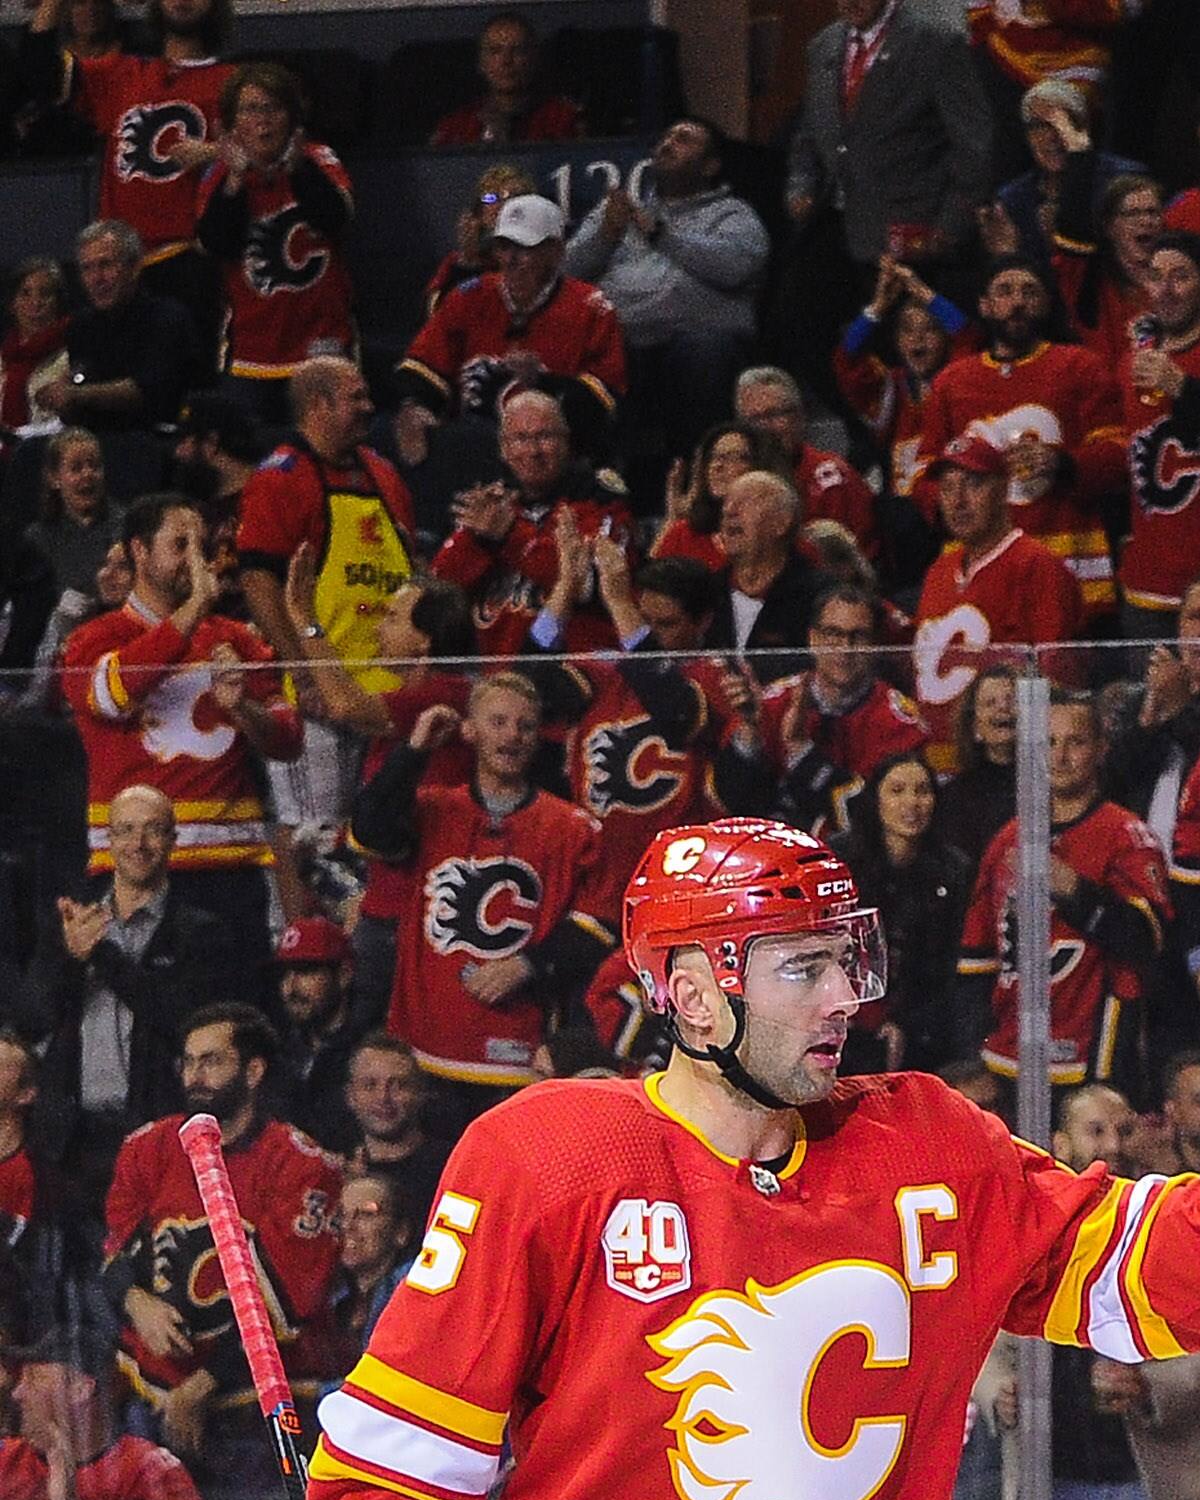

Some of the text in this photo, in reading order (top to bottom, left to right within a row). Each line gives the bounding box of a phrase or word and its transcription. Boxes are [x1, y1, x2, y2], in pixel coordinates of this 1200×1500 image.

[405, 1191, 482, 1295] 5
[602, 1199, 688, 1264] 40
[894, 1182, 958, 1291] C
